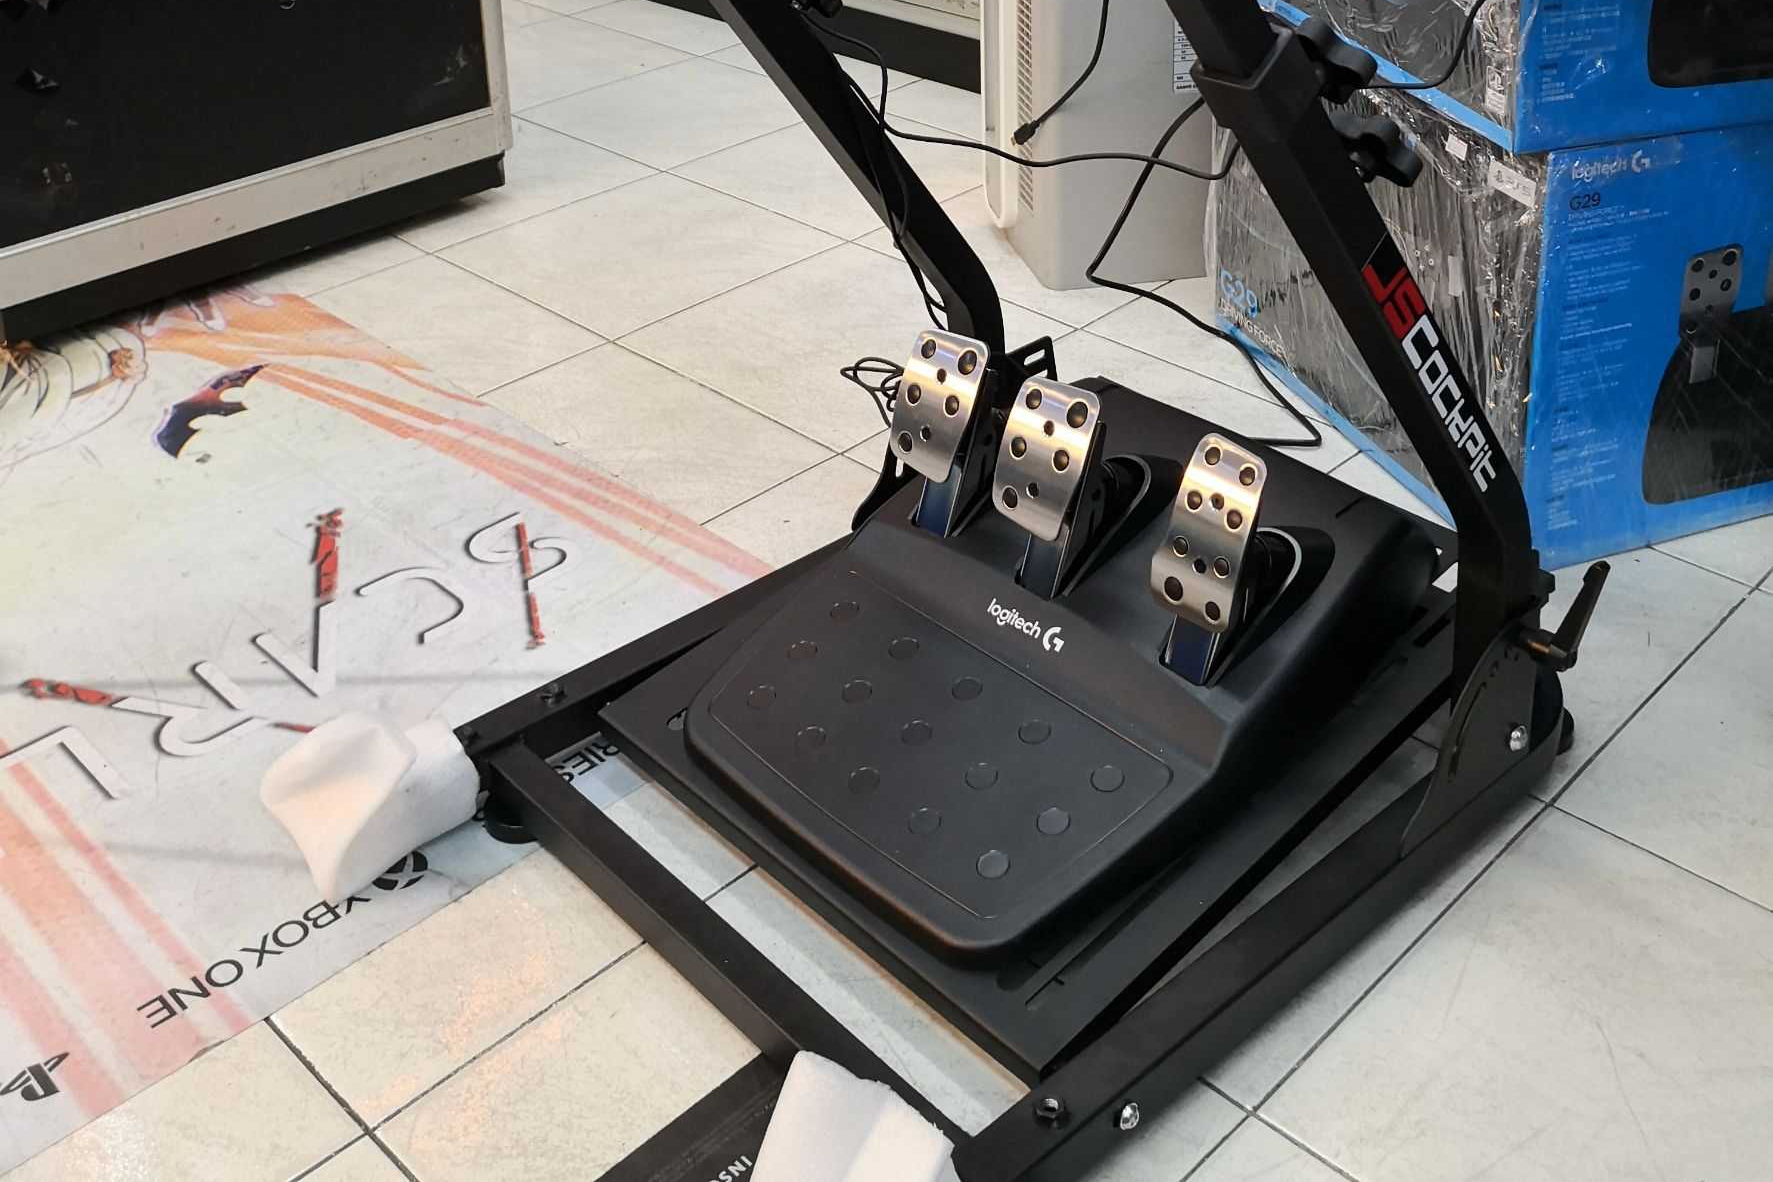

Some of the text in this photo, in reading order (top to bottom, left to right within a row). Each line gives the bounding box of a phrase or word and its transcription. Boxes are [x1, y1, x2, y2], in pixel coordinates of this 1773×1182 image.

[1569, 192, 1601, 211] G29
[986, 598, 1042, 640] logitech
[0, 508, 575, 800] SCARL
[554, 744, 620, 783] RIES
[136, 957, 244, 1029] ONE
[709, 1155, 753, 1182] INS
